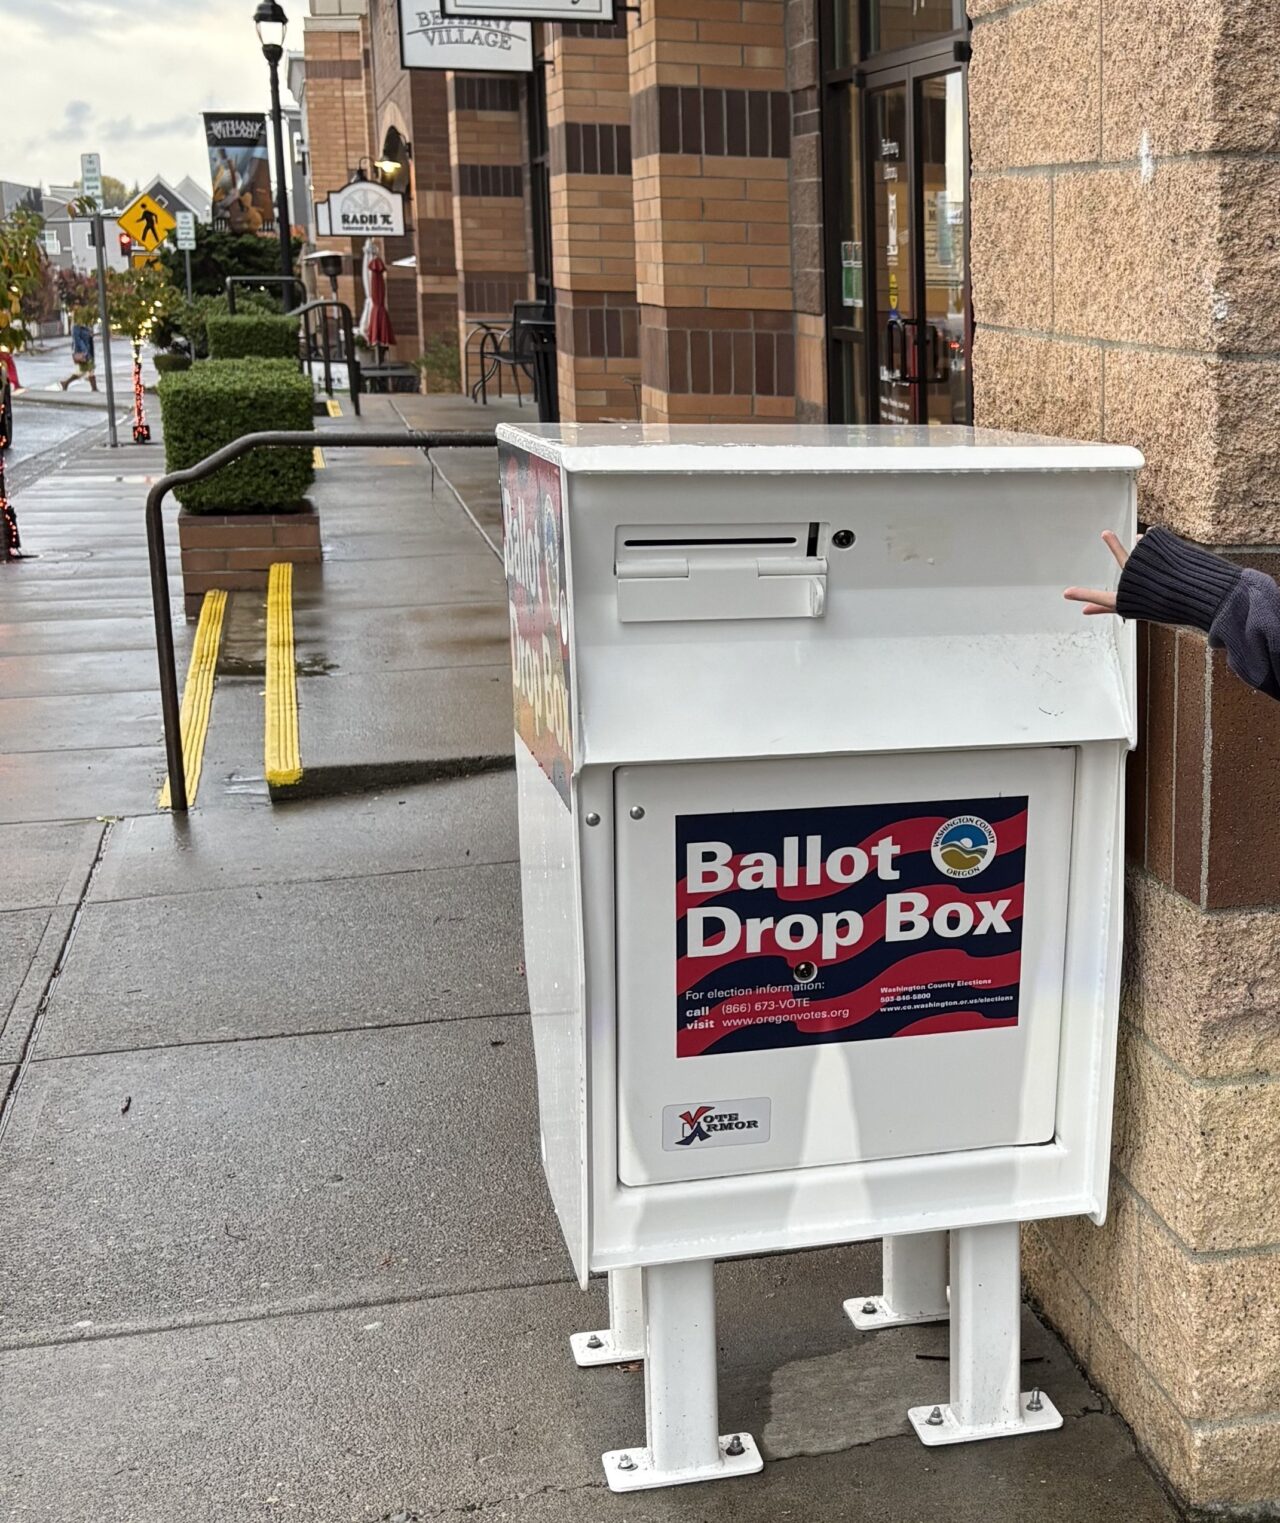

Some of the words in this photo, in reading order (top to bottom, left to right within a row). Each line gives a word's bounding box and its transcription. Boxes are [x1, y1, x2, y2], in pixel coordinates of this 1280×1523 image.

[421, 29, 511, 51] VILLAGE
[503, 487, 543, 604] Ballot
[509, 600, 542, 736] Drop
[542, 632, 572, 761] Box
[933, 817, 974, 847] WASHINGTON
[975, 819, 995, 844] COUNTY
[686, 834, 901, 894] Ballot
[946, 866, 980, 877] OREGON
[686, 906, 864, 960] Drop
[885, 891, 1012, 942] Box
[686, 990, 704, 1000] For
[707, 986, 753, 999] election
[756, 981, 825, 995] information:
[880, 985, 926, 994] Washington
[927, 982, 955, 990] County
[956, 979, 992, 988] Elections
[686, 1006, 710, 1017] call
[721, 1002, 751, 1015] (866)
[754, 997, 811, 1011] 673-VOTE
[686, 1020, 715, 1030] visit
[722, 1009, 850, 1028] www.oregonvotes.org
[679, 1106, 739, 1130] VOTE
[675, 1121, 759, 1146] ARMOR
